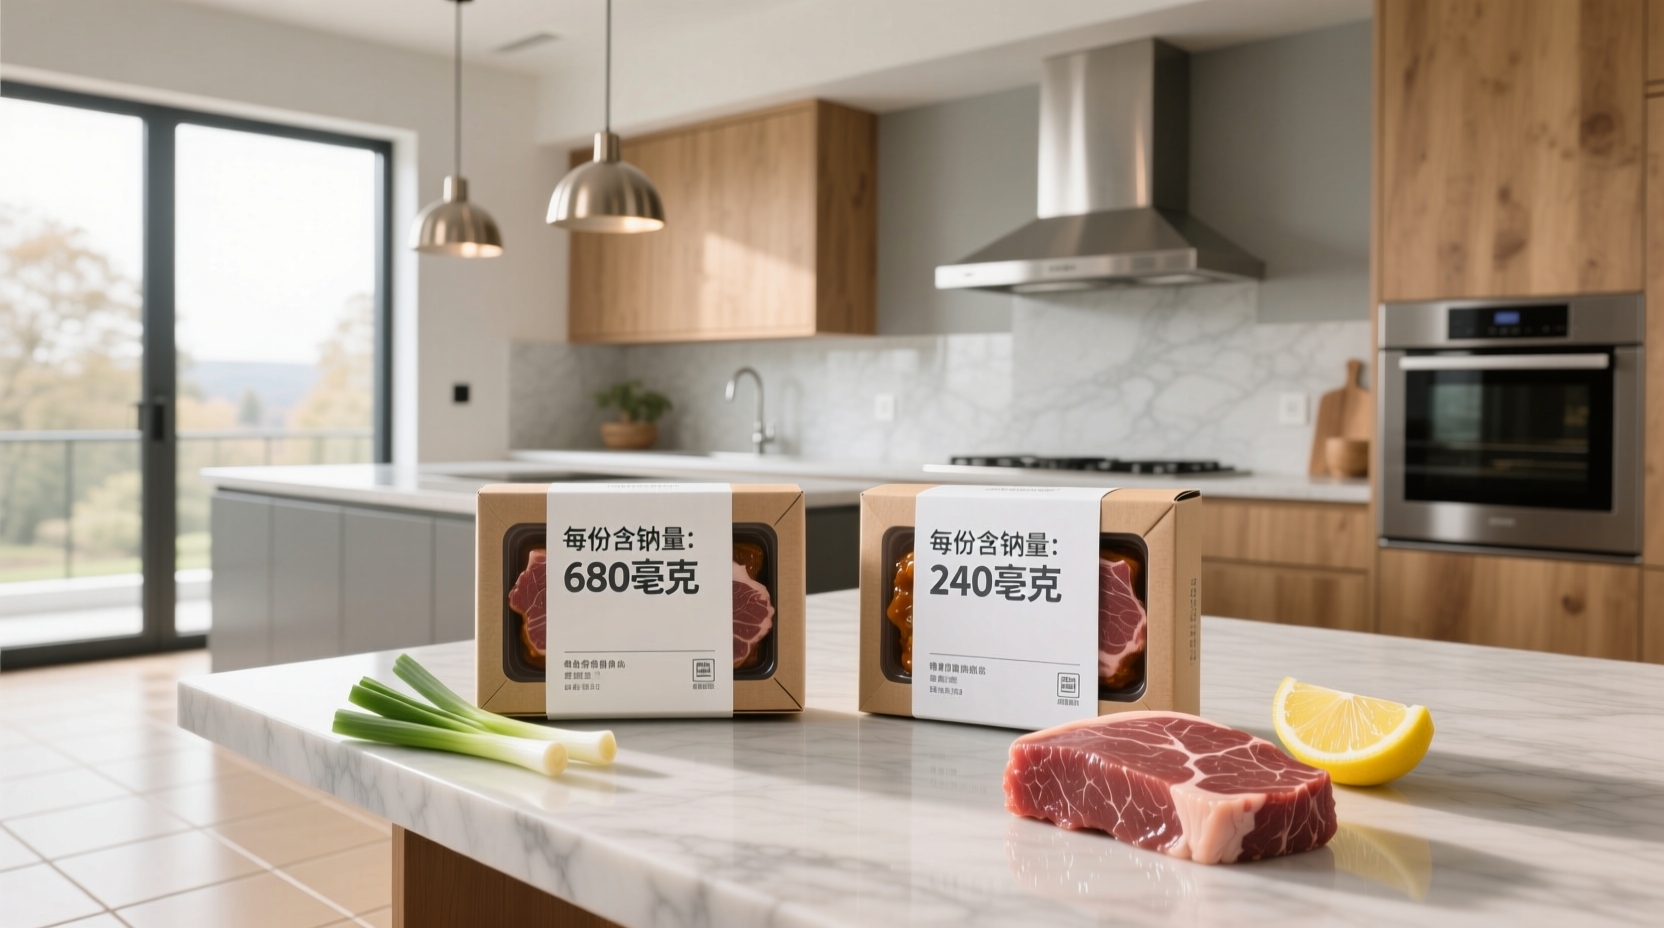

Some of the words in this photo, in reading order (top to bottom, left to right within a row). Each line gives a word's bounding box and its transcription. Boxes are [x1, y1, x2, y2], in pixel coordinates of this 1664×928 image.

[563, 525, 694, 553] 每份含钠量：
[929, 528, 1058, 558] 每份含钠量：
[564, 558, 700, 596] 680毫克
[929, 563, 1062, 603] 240毫克
